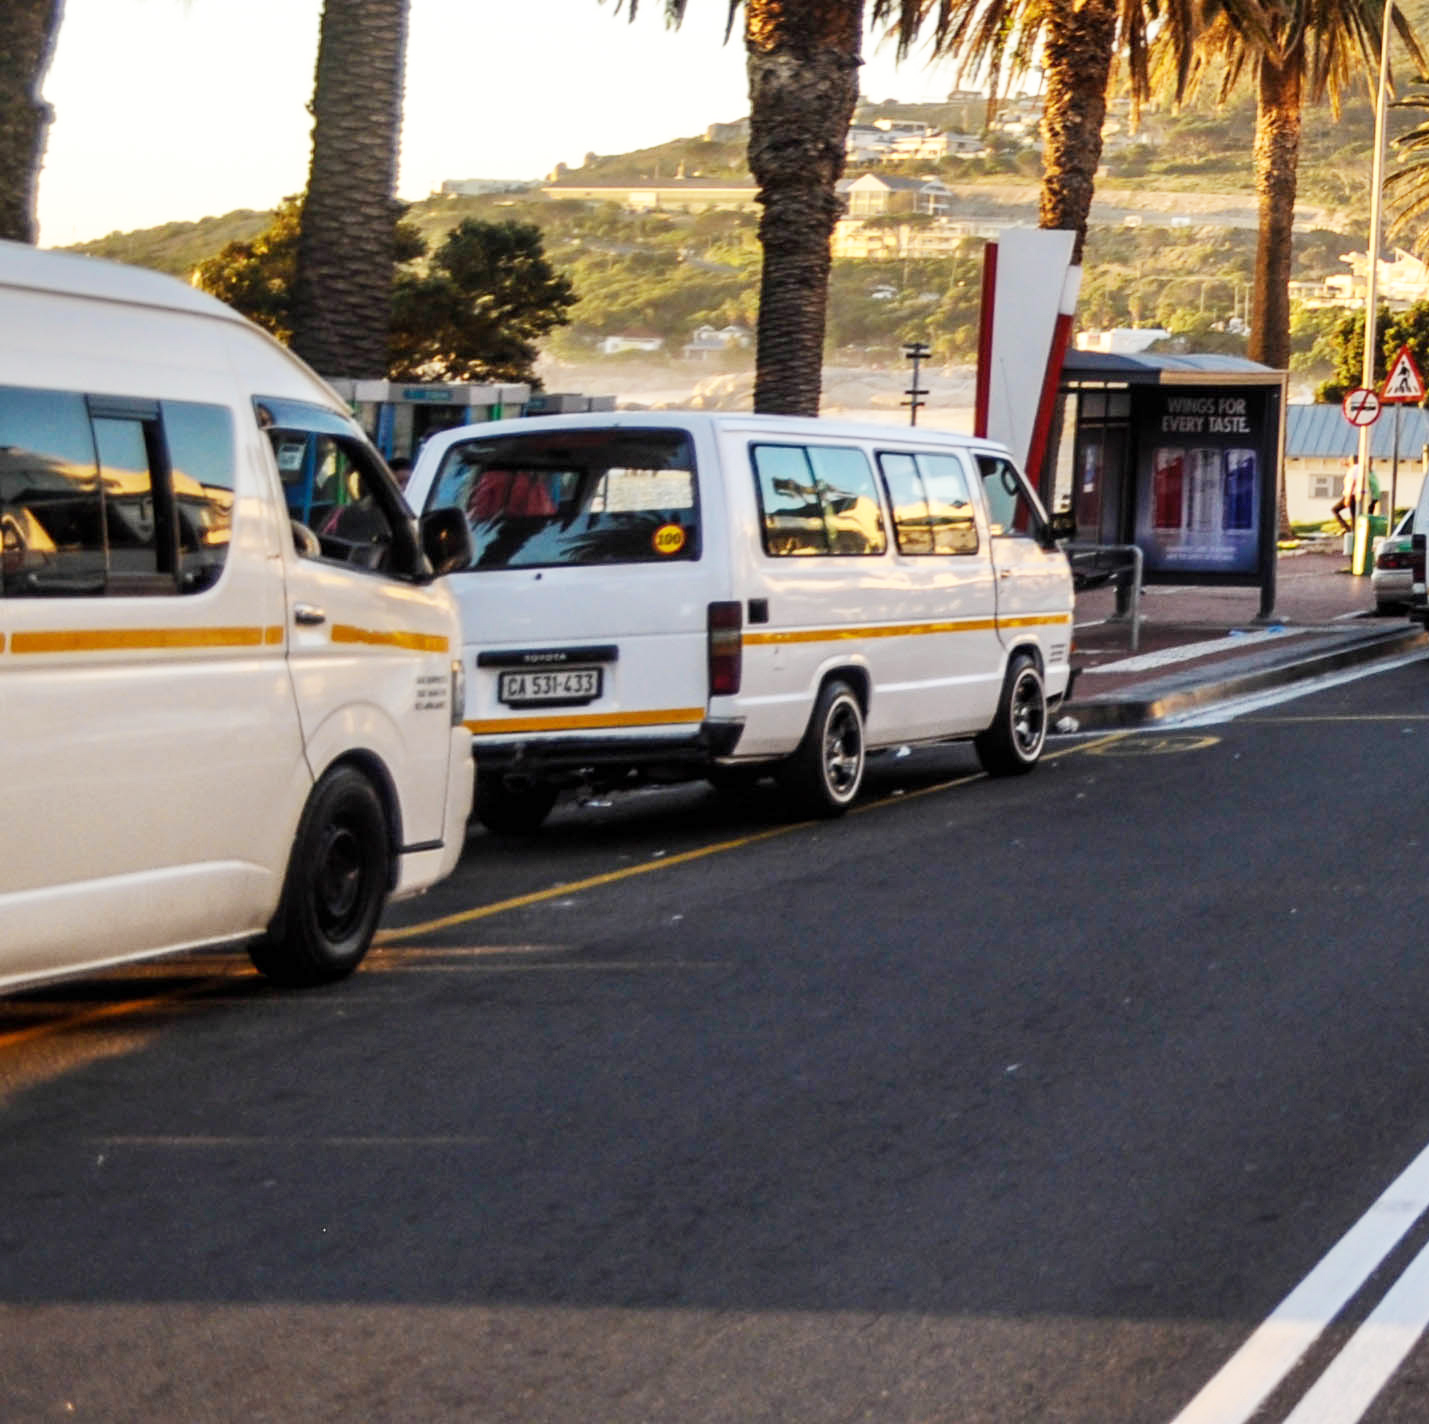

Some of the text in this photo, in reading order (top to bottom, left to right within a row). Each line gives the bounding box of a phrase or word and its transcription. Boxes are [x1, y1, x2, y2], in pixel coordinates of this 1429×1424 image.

[1167, 397, 1247, 415] WINGS FOR
[1161, 415, 1204, 433] EVERY
[524, 652, 567, 663] TOYOTA
[507, 673, 594, 697] CA 531-433
